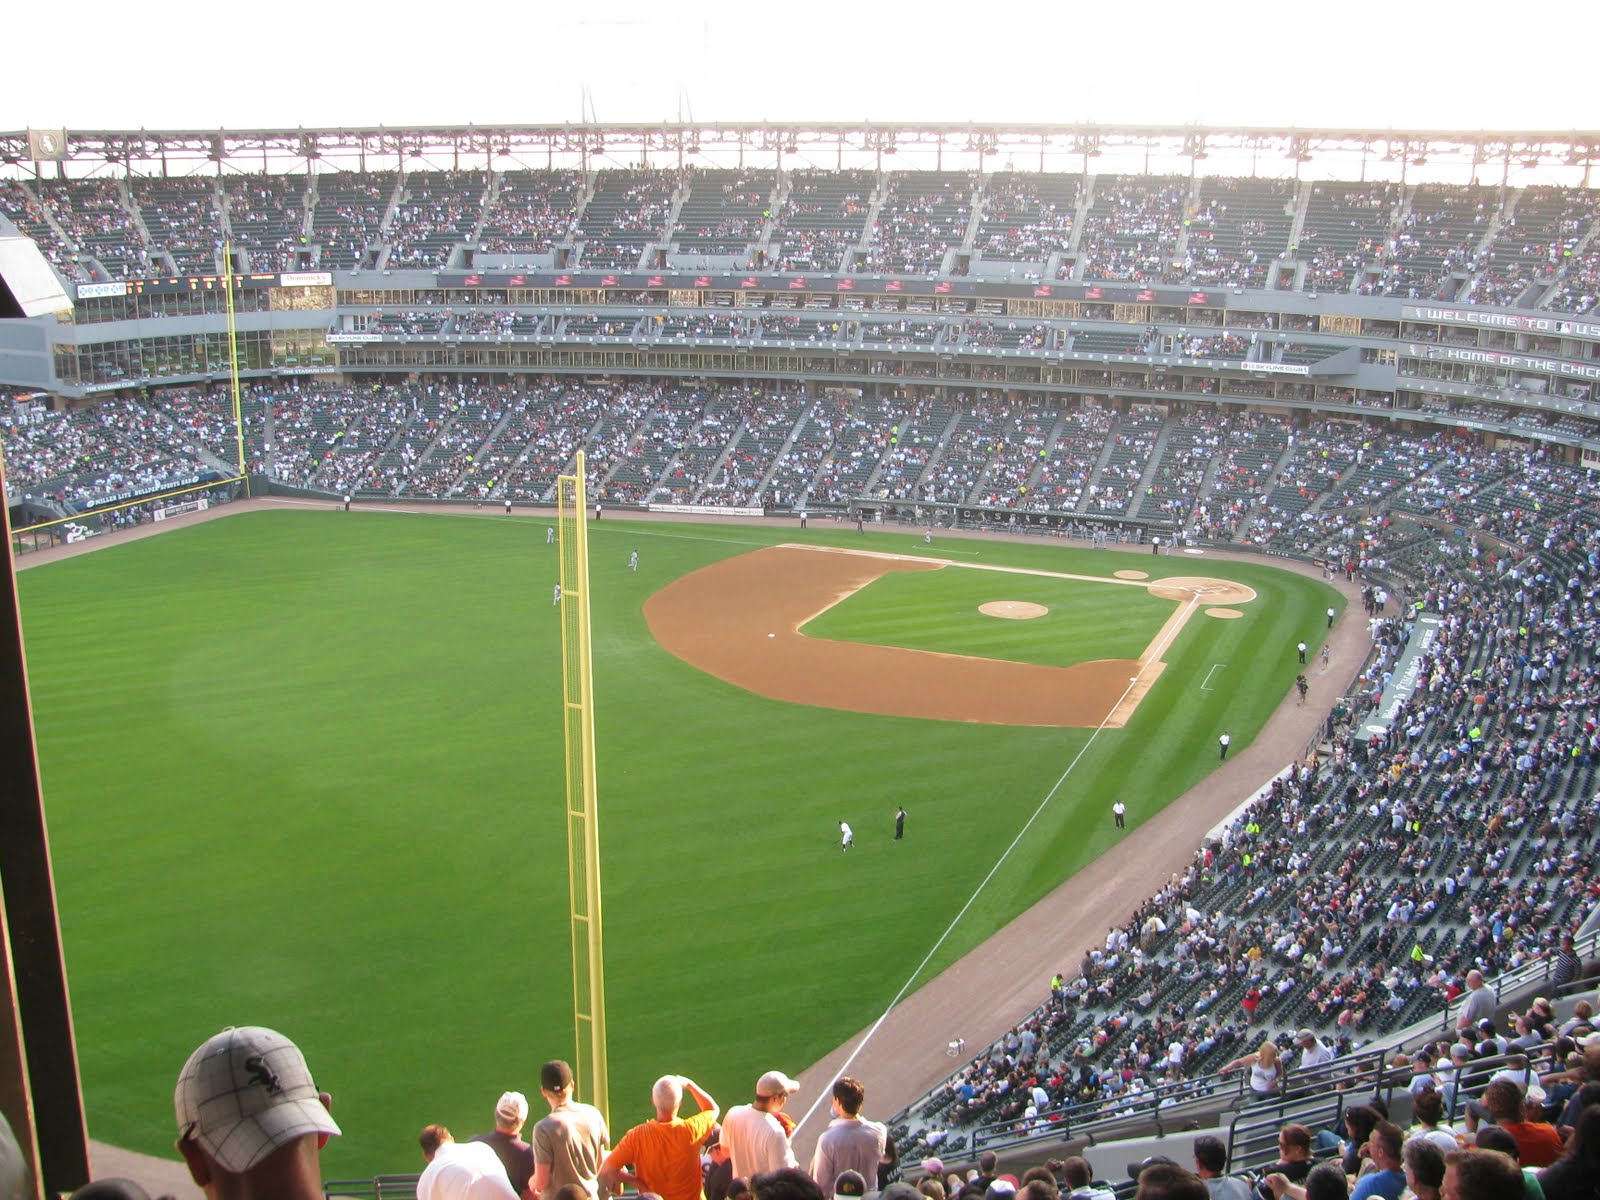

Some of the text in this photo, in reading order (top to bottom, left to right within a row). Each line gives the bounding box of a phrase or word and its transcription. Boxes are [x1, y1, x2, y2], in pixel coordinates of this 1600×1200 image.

[1427, 309, 1517, 327] WELCOME
[1524, 318, 1549, 330] TO
[1447, 349, 1496, 363] HOME
[1499, 355, 1521, 366] OF
[1524, 358, 1557, 371] THE
[95, 495, 118, 506] MILLER
[118, 492, 132, 500] LITE
[160, 481, 180, 490] SPORTS
